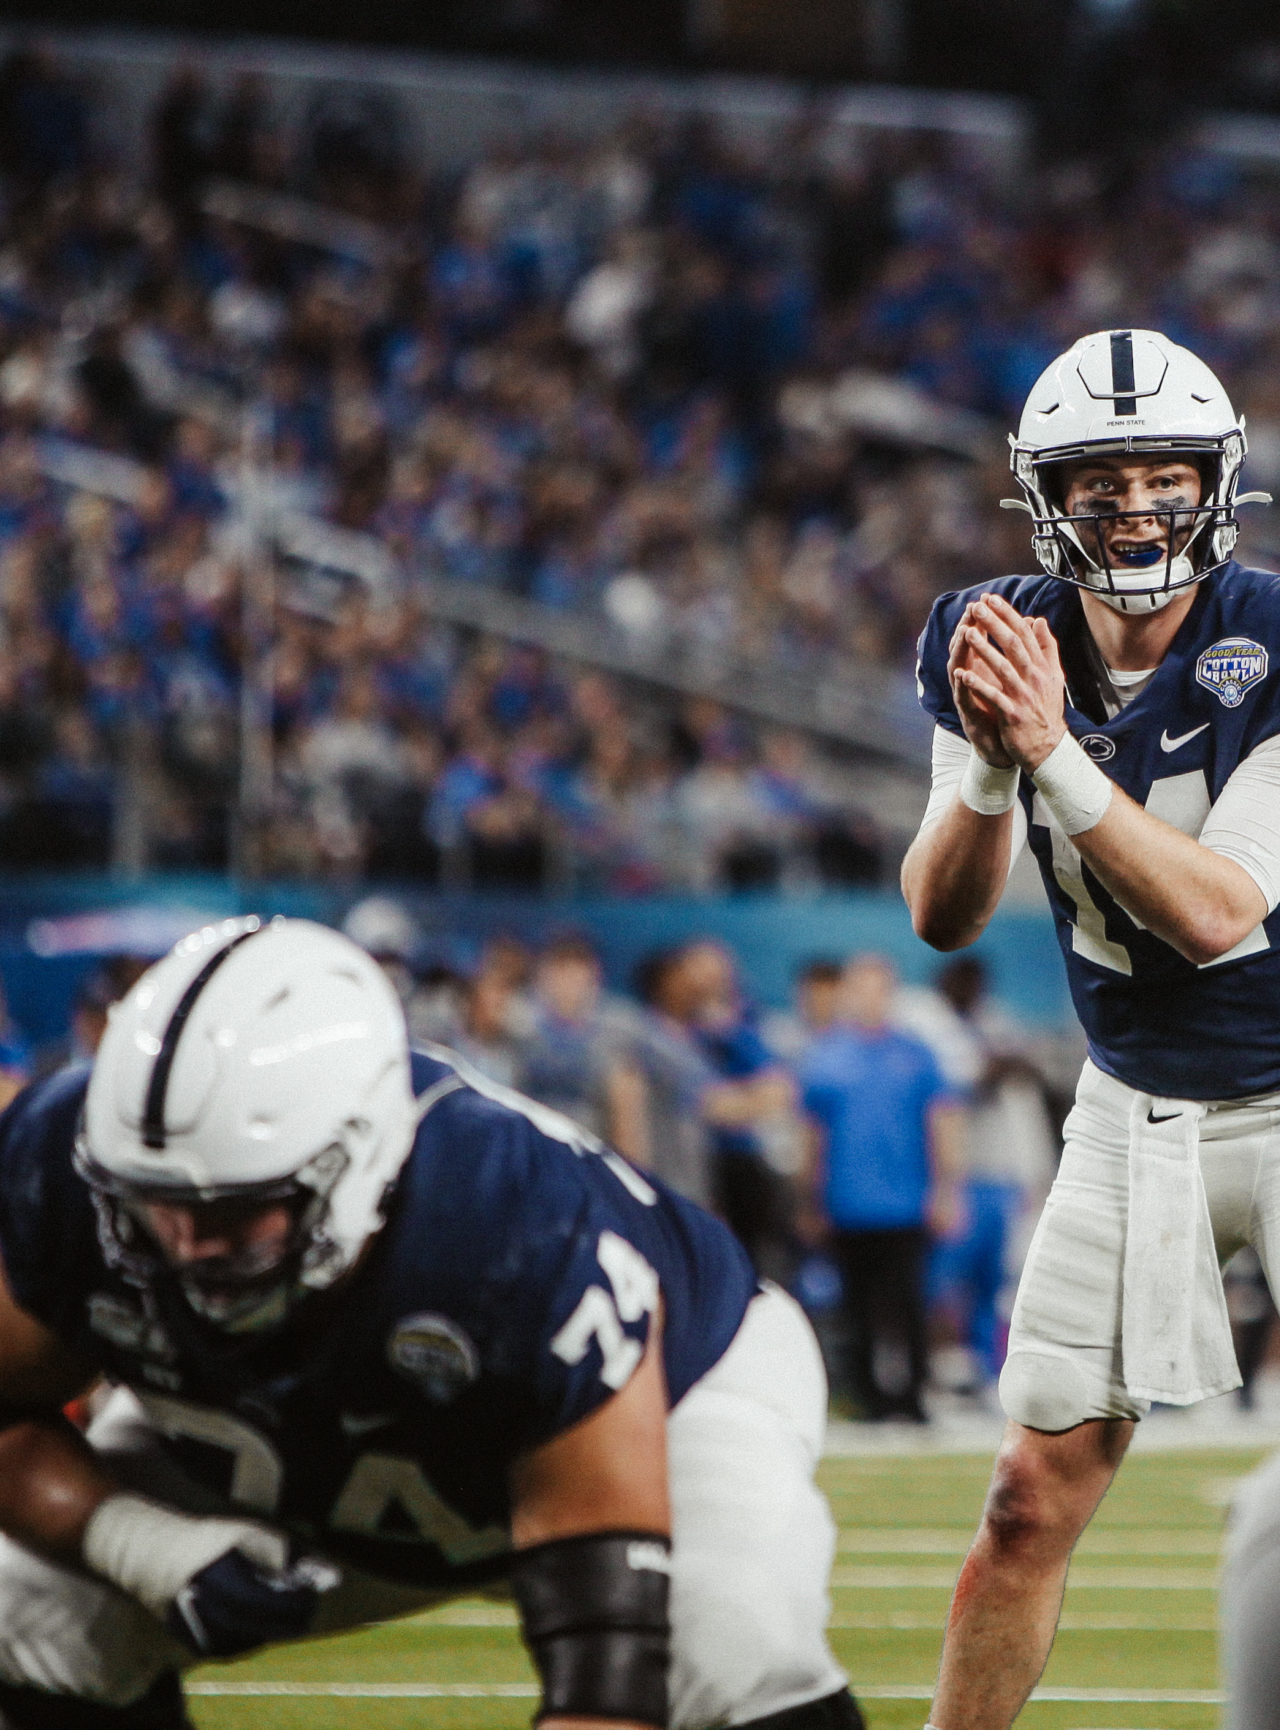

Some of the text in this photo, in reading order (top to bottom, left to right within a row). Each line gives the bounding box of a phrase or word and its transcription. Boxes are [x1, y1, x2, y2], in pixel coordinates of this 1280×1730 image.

[1205, 646, 1261, 658] GOODYEAR
[1202, 656, 1261, 679] COTTON
[1212, 668, 1250, 684] BOWL
[551, 1229, 661, 1391] 74
